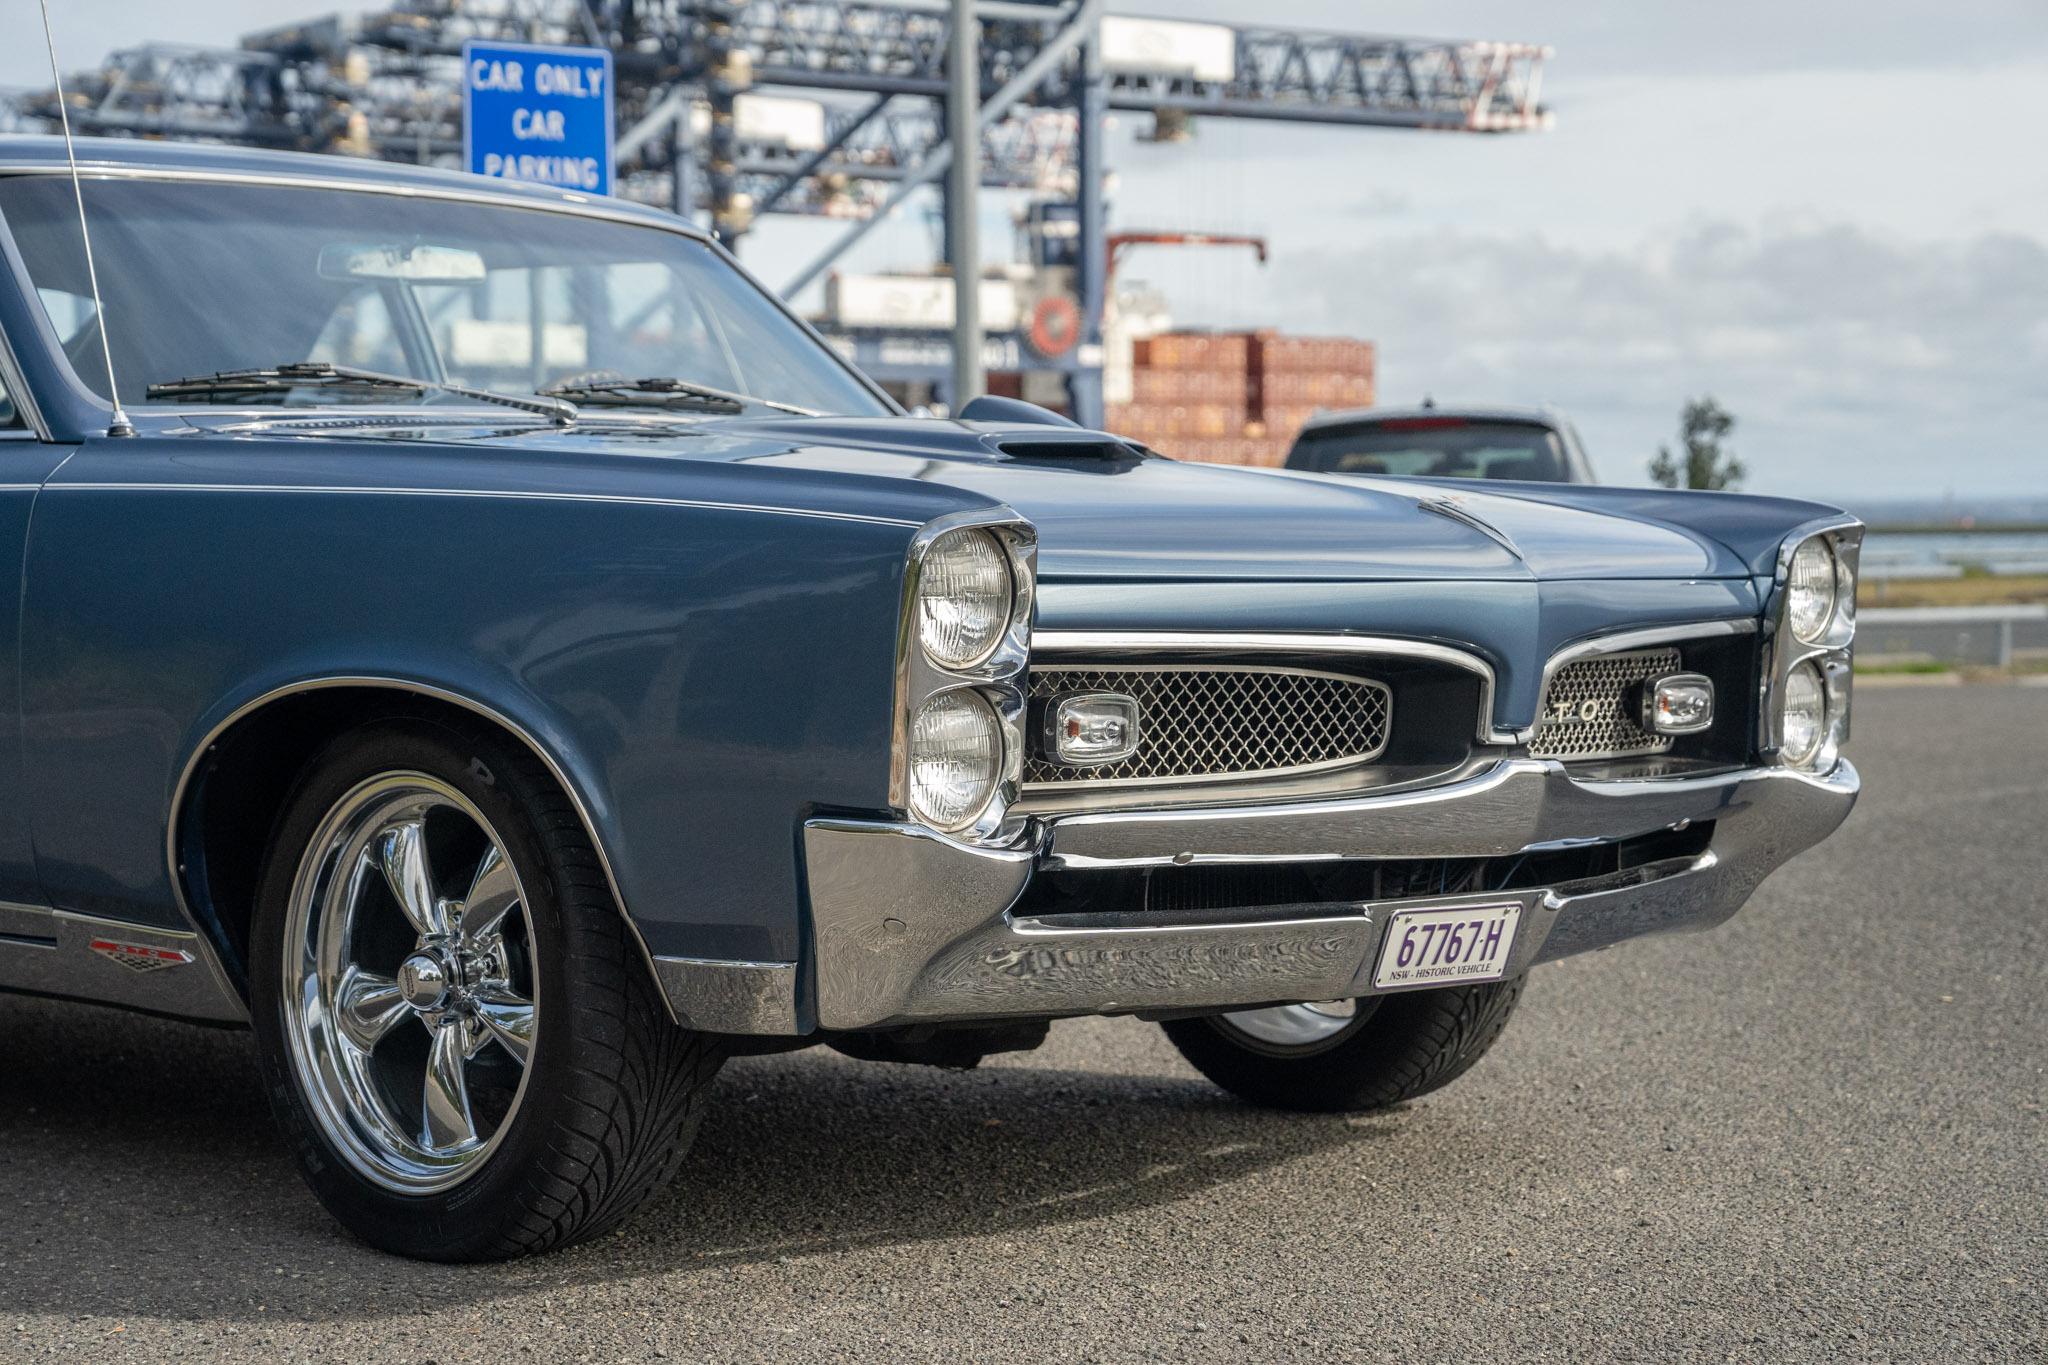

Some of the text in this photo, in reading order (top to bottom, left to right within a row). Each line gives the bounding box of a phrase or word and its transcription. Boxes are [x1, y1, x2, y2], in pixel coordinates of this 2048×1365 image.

[472, 59, 603, 98] CAR ONLY
[511, 108, 565, 141] CAR
[484, 153, 599, 189] PARKING
[1390, 971, 1410, 980] NSW
[1415, 966, 1456, 978] HISTORIC
[1458, 963, 1491, 974] VEHICLE
